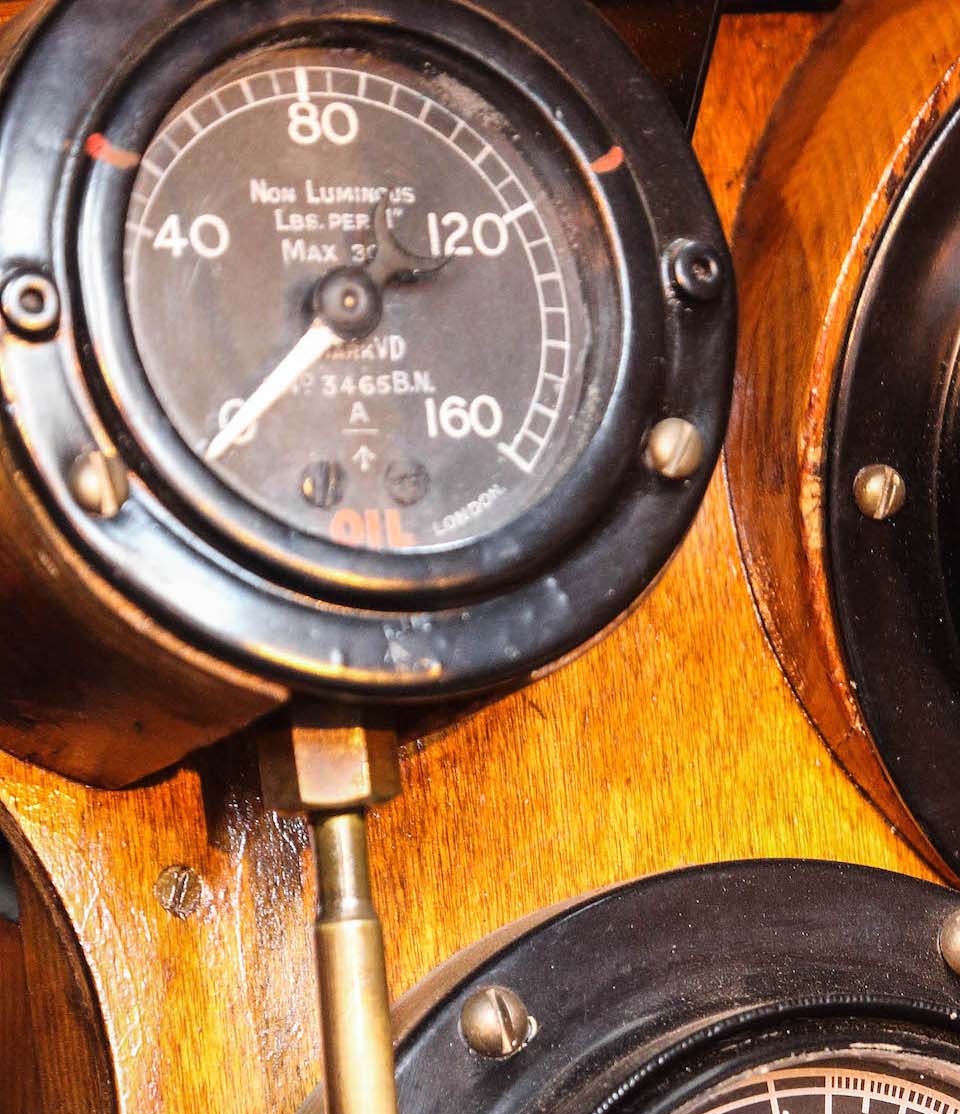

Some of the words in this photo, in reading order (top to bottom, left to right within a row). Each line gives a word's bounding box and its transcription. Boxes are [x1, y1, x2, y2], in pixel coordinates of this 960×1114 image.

[287, 102, 359, 145] 80
[153, 214, 230, 258] 40
[281, 238, 339, 265] MAX
[427, 210, 509, 257] 120
[425, 395, 503, 438] 160
[329, 509, 416, 549] OIL
